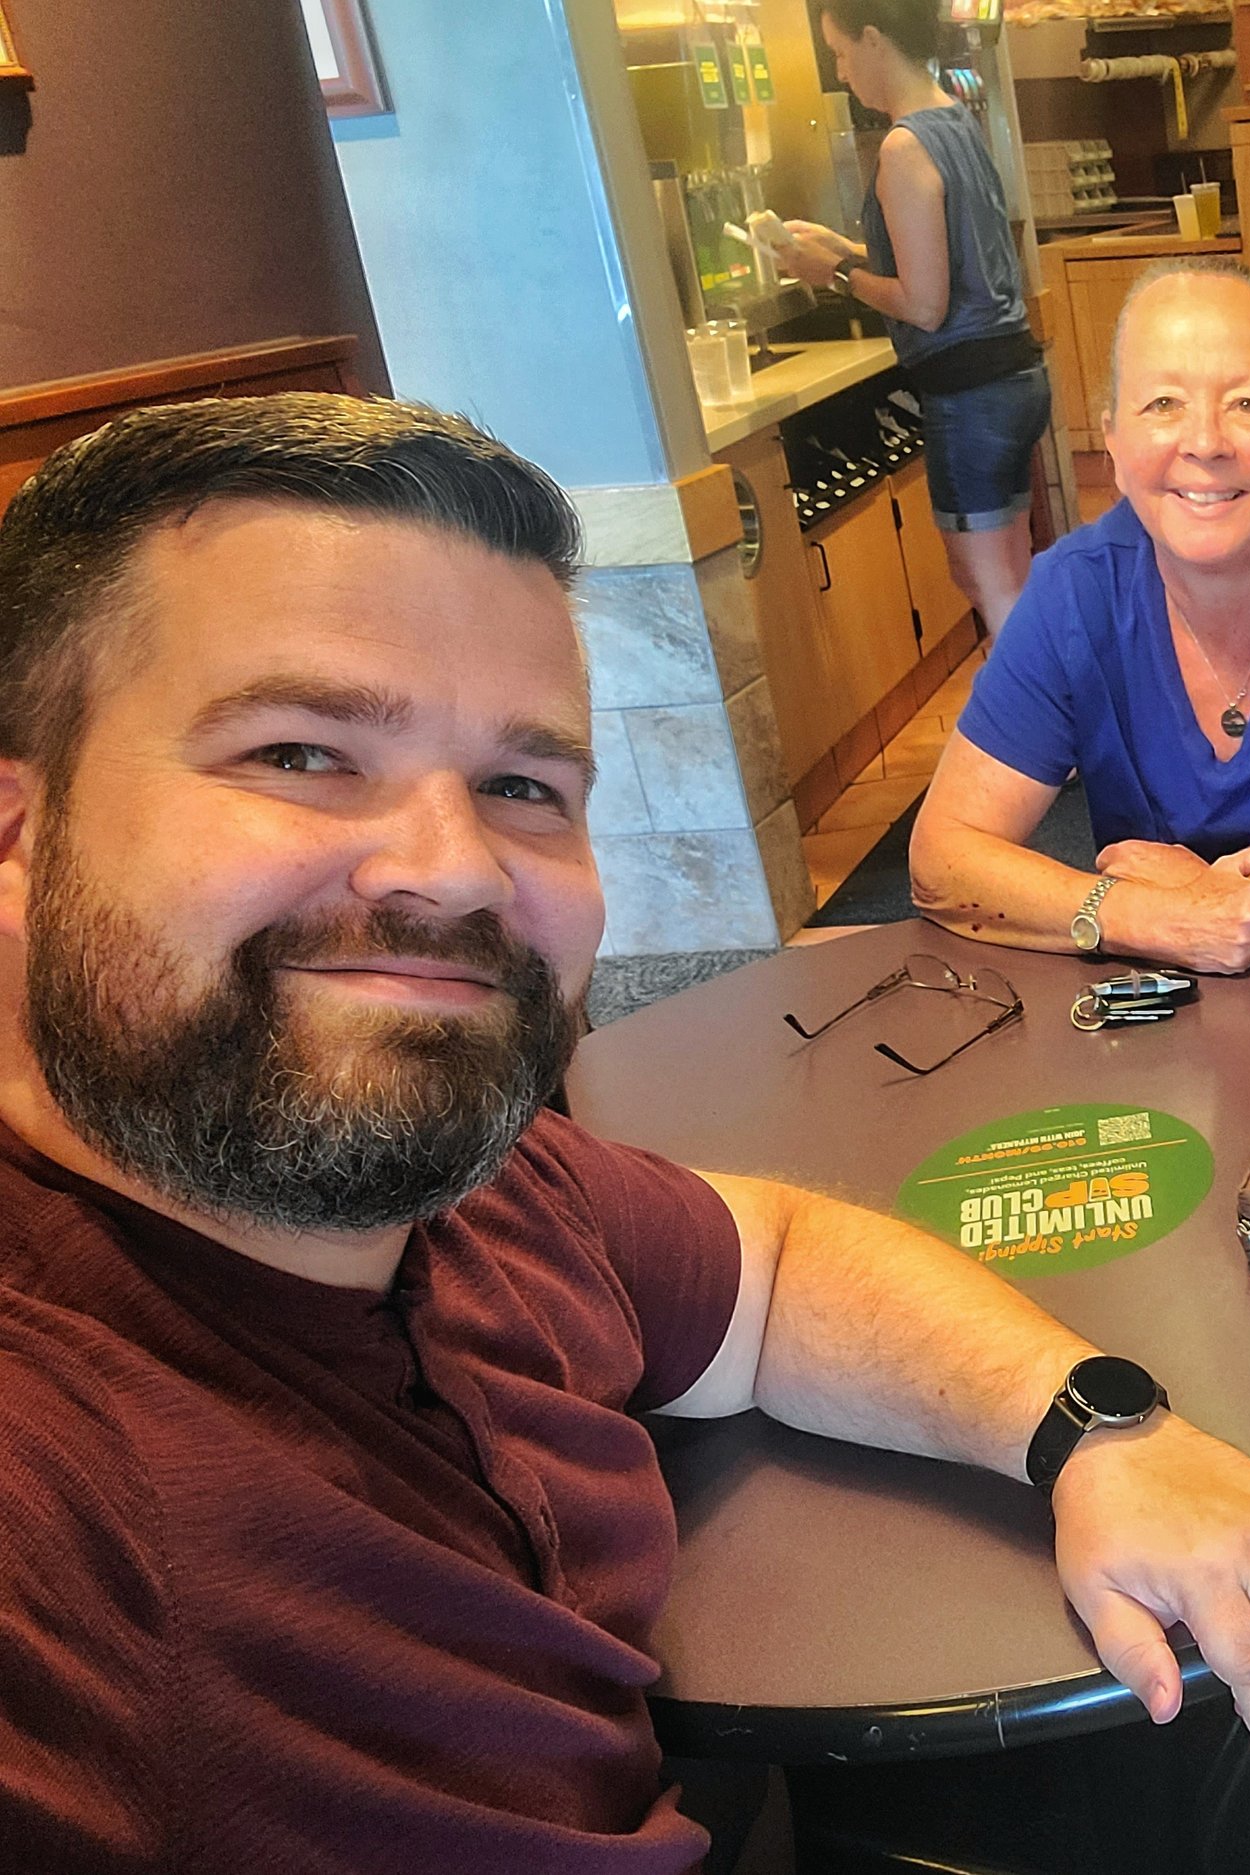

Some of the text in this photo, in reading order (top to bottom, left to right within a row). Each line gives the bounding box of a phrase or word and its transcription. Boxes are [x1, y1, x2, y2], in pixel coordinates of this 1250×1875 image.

[1040, 1132, 1063, 1143] WITH
[1064, 1129, 1086, 1139] JOIN
[1024, 1168, 1047, 1179] and
[1090, 1160, 1147, 1175] Unlimited
[1042, 1170, 1088, 1183] Charged
[960, 1171, 1150, 1223] SIP CLUB
[960, 1194, 1154, 1248] UNLIMITED
[1072, 1222, 1139, 1250] Start
